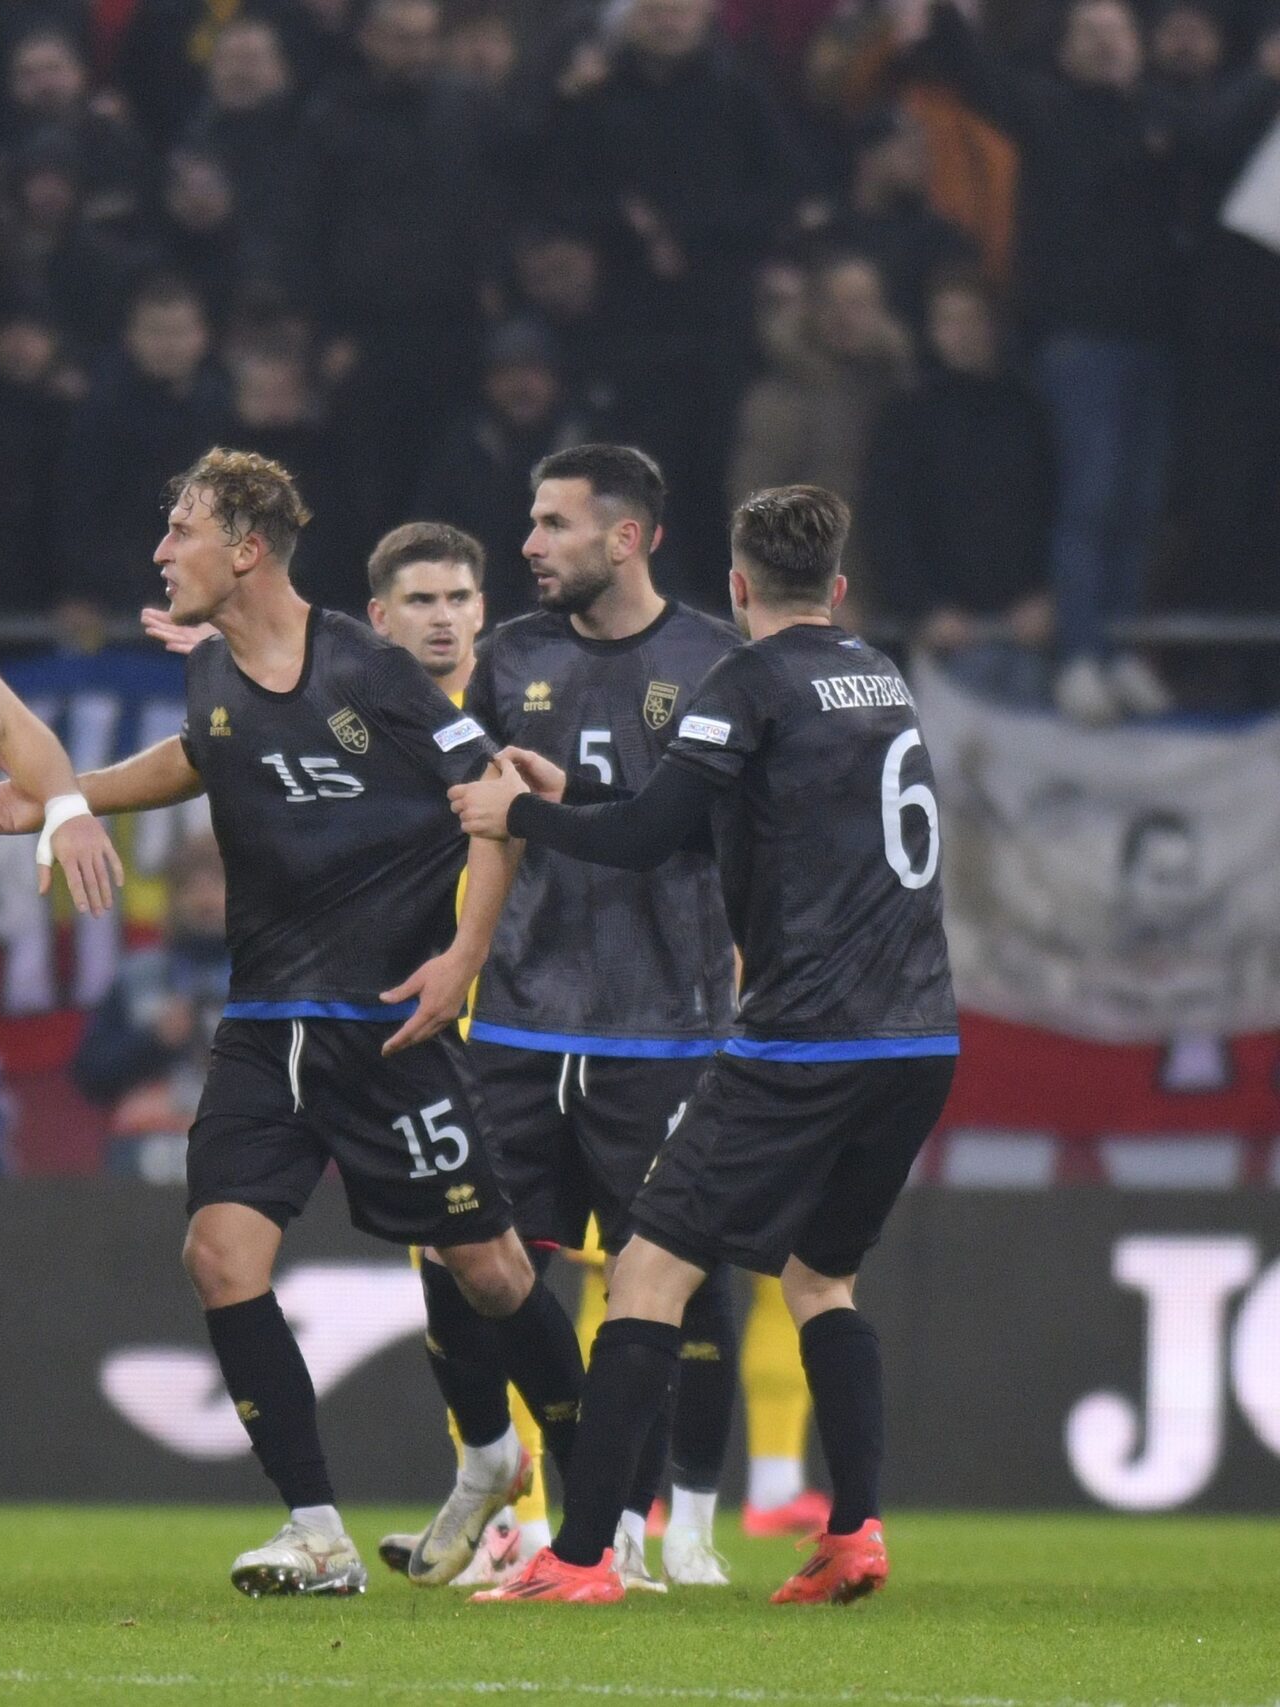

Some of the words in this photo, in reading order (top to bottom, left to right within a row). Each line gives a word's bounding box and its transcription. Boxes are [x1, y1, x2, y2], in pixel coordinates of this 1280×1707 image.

[811, 675, 918, 716] REXHBEC
[261, 753, 365, 802] 15
[580, 731, 612, 785] 5
[882, 728, 940, 889] 6
[392, 1099, 469, 1178] 15
